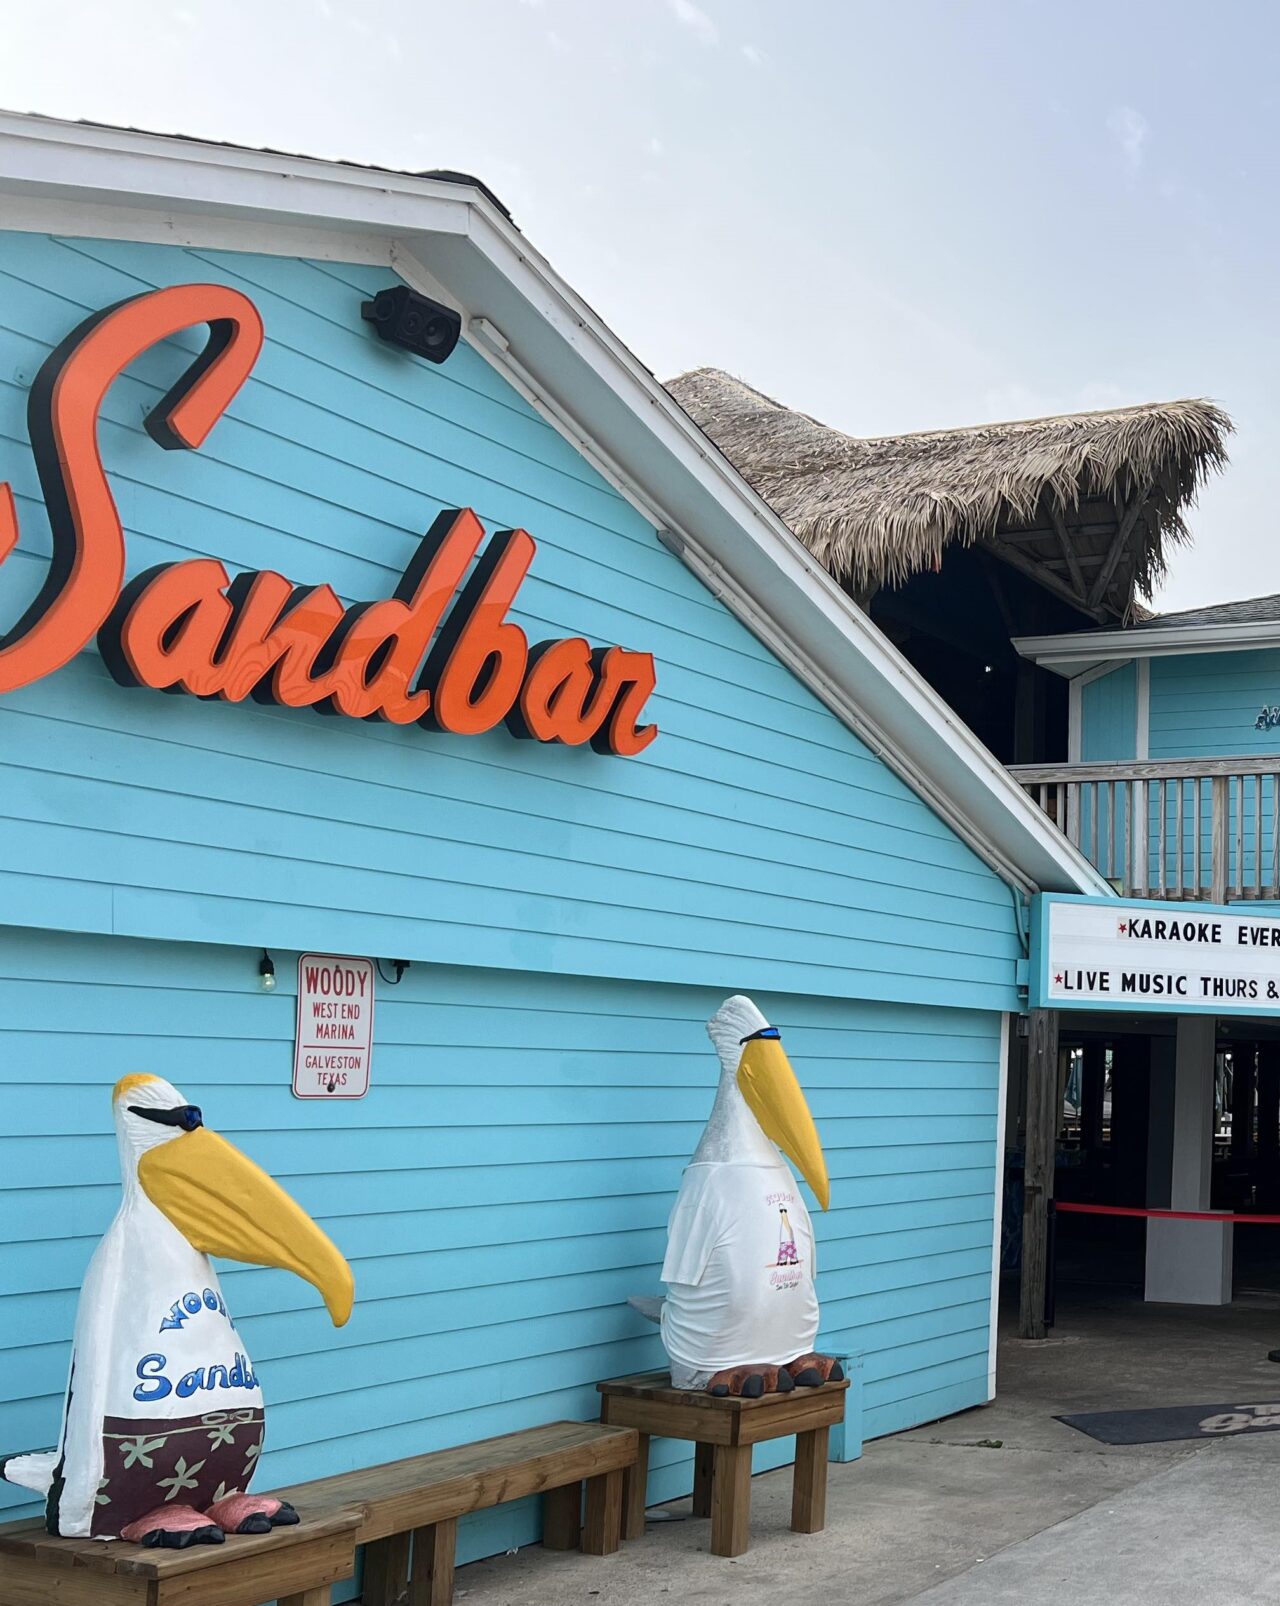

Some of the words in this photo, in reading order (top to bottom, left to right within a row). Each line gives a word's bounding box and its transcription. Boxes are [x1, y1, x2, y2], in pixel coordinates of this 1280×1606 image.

[0, 282, 657, 756] Sandbar
[1127, 918, 1222, 943] KARAOKE
[305, 966, 368, 997] WOODY
[1063, 970, 1110, 992] LIVE
[1121, 973, 1188, 995] MUSIC
[1200, 976, 1259, 998] THURS
[1266, 980, 1280, 1000] &
[312, 1001, 339, 1019] WEST
[341, 1003, 360, 1020] END
[315, 1023, 355, 1040] MARINA
[305, 1055, 362, 1070] GALVESTON
[317, 1072, 347, 1086] TEXAS
[159, 1288, 235, 1334] WOO
[133, 1352, 260, 1402] Sandb
